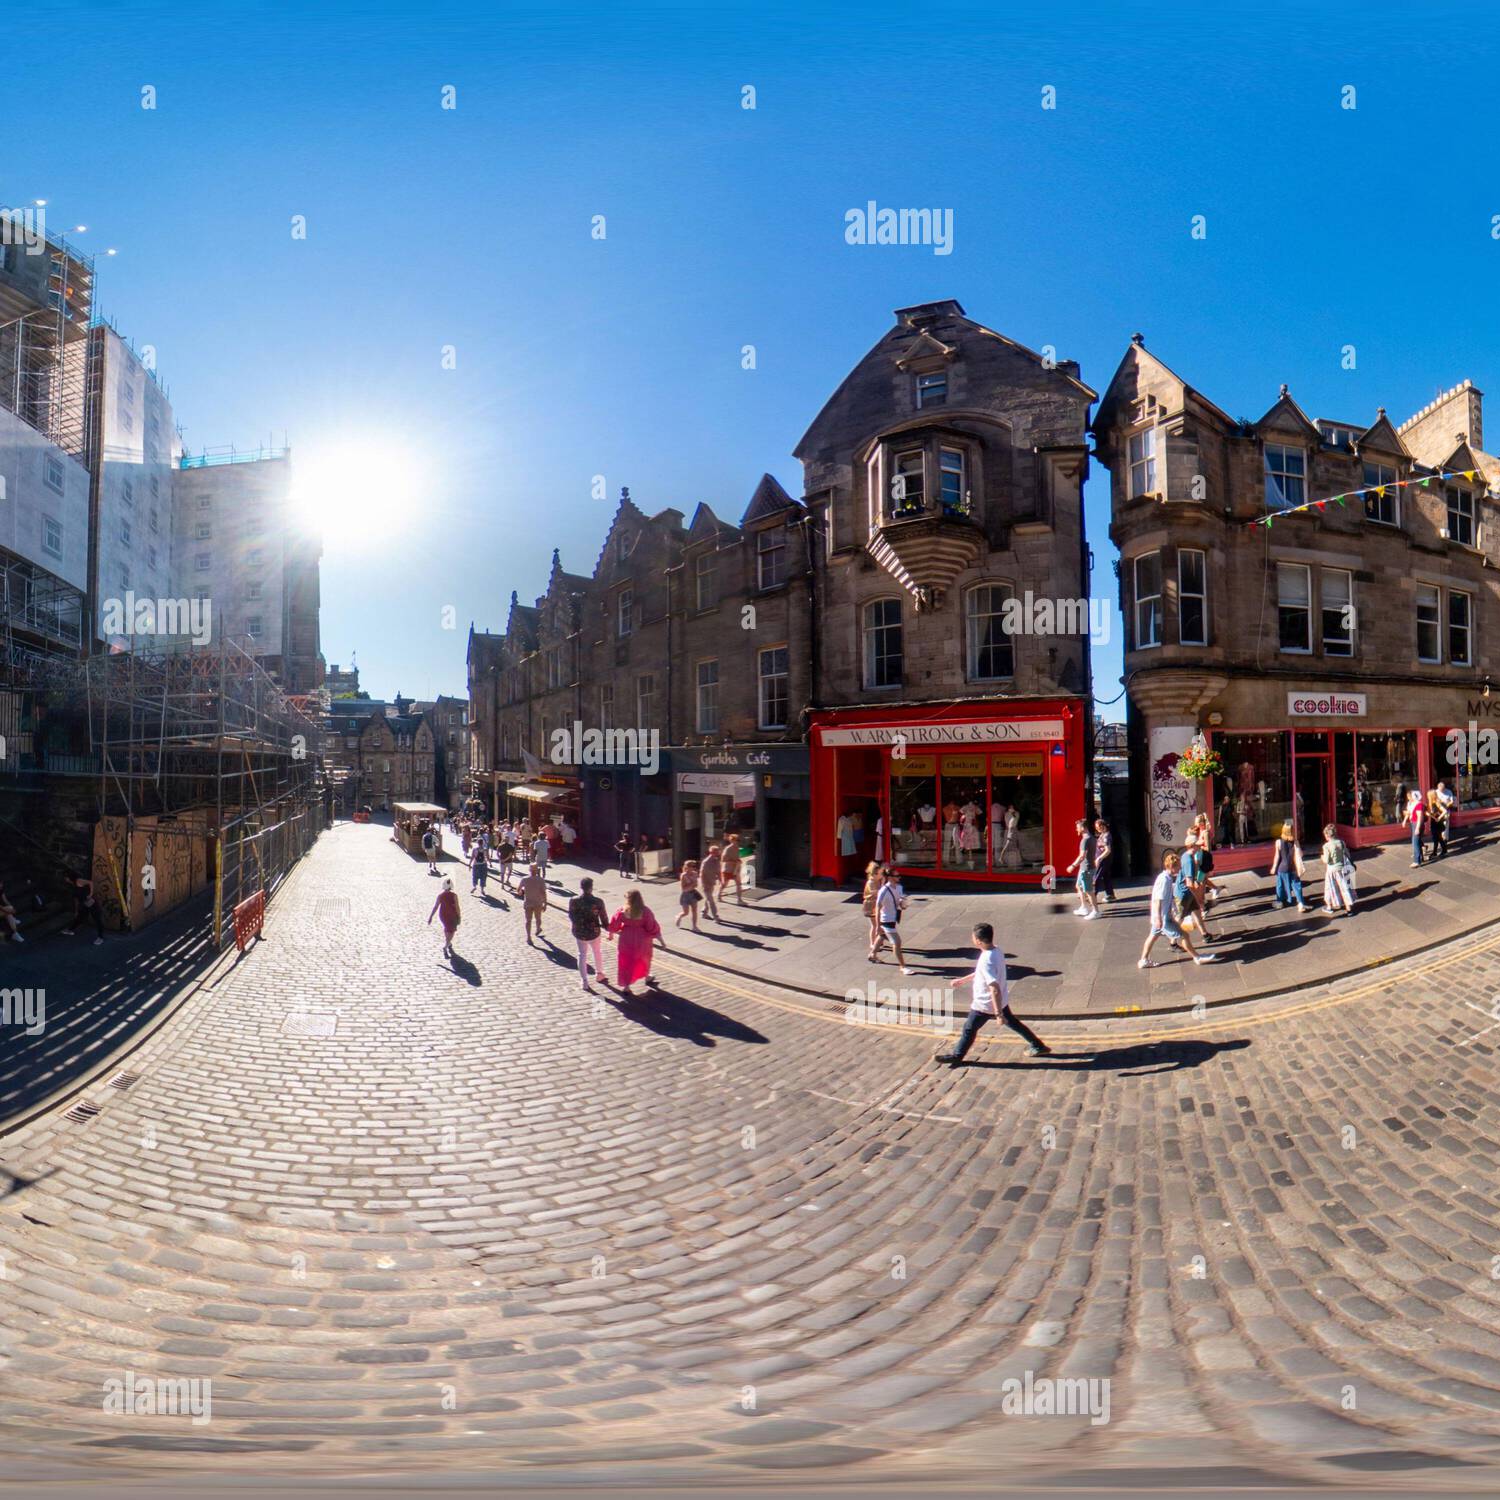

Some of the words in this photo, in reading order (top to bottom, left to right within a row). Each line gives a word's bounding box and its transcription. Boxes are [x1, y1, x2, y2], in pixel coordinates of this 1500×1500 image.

[864, 726, 965, 744] ARMSTRONG
[971, 728, 982, 740] &
[986, 723, 1022, 739] SON
[700, 752, 738, 769] Gurkha
[746, 751, 770, 765] Cafe
[946, 760, 980, 770] Clothing
[995, 759, 1038, 770] Emporium
